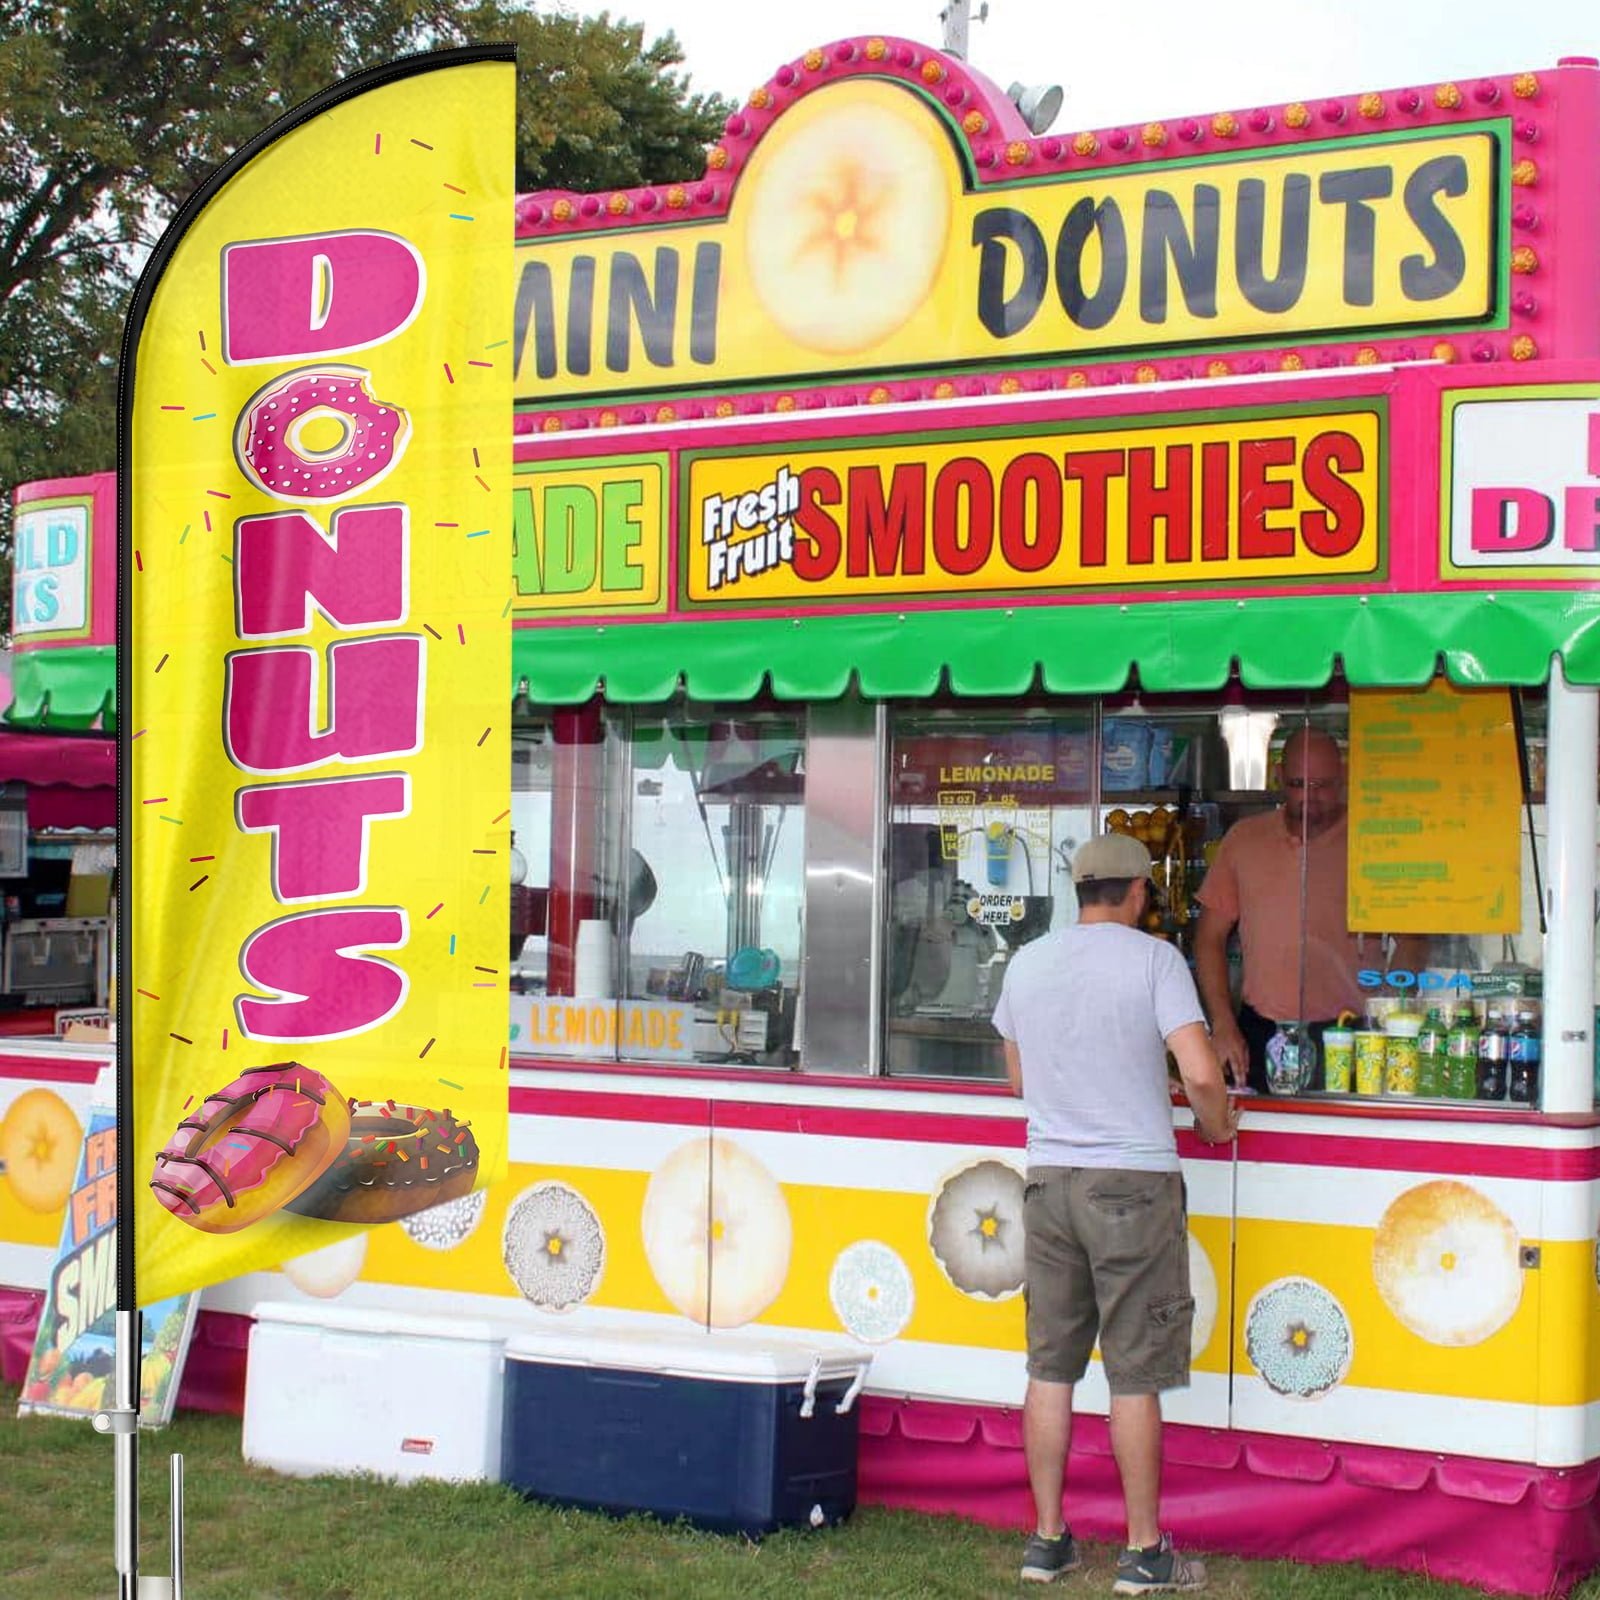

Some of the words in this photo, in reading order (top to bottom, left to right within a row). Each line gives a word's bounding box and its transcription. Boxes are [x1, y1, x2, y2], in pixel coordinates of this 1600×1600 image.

[972, 154, 1469, 339] DONUTS
[703, 464, 800, 545] Fresh
[792, 430, 1364, 581] SMOOTHIES
[707, 518, 795, 591] Fruit
[940, 765, 1054, 783] LEMONADE
[980, 895, 1013, 907] ORDER
[983, 911, 1009, 923] HERE
[1358, 970, 1474, 991] SODA
[531, 1003, 685, 1049] LEMONADE
